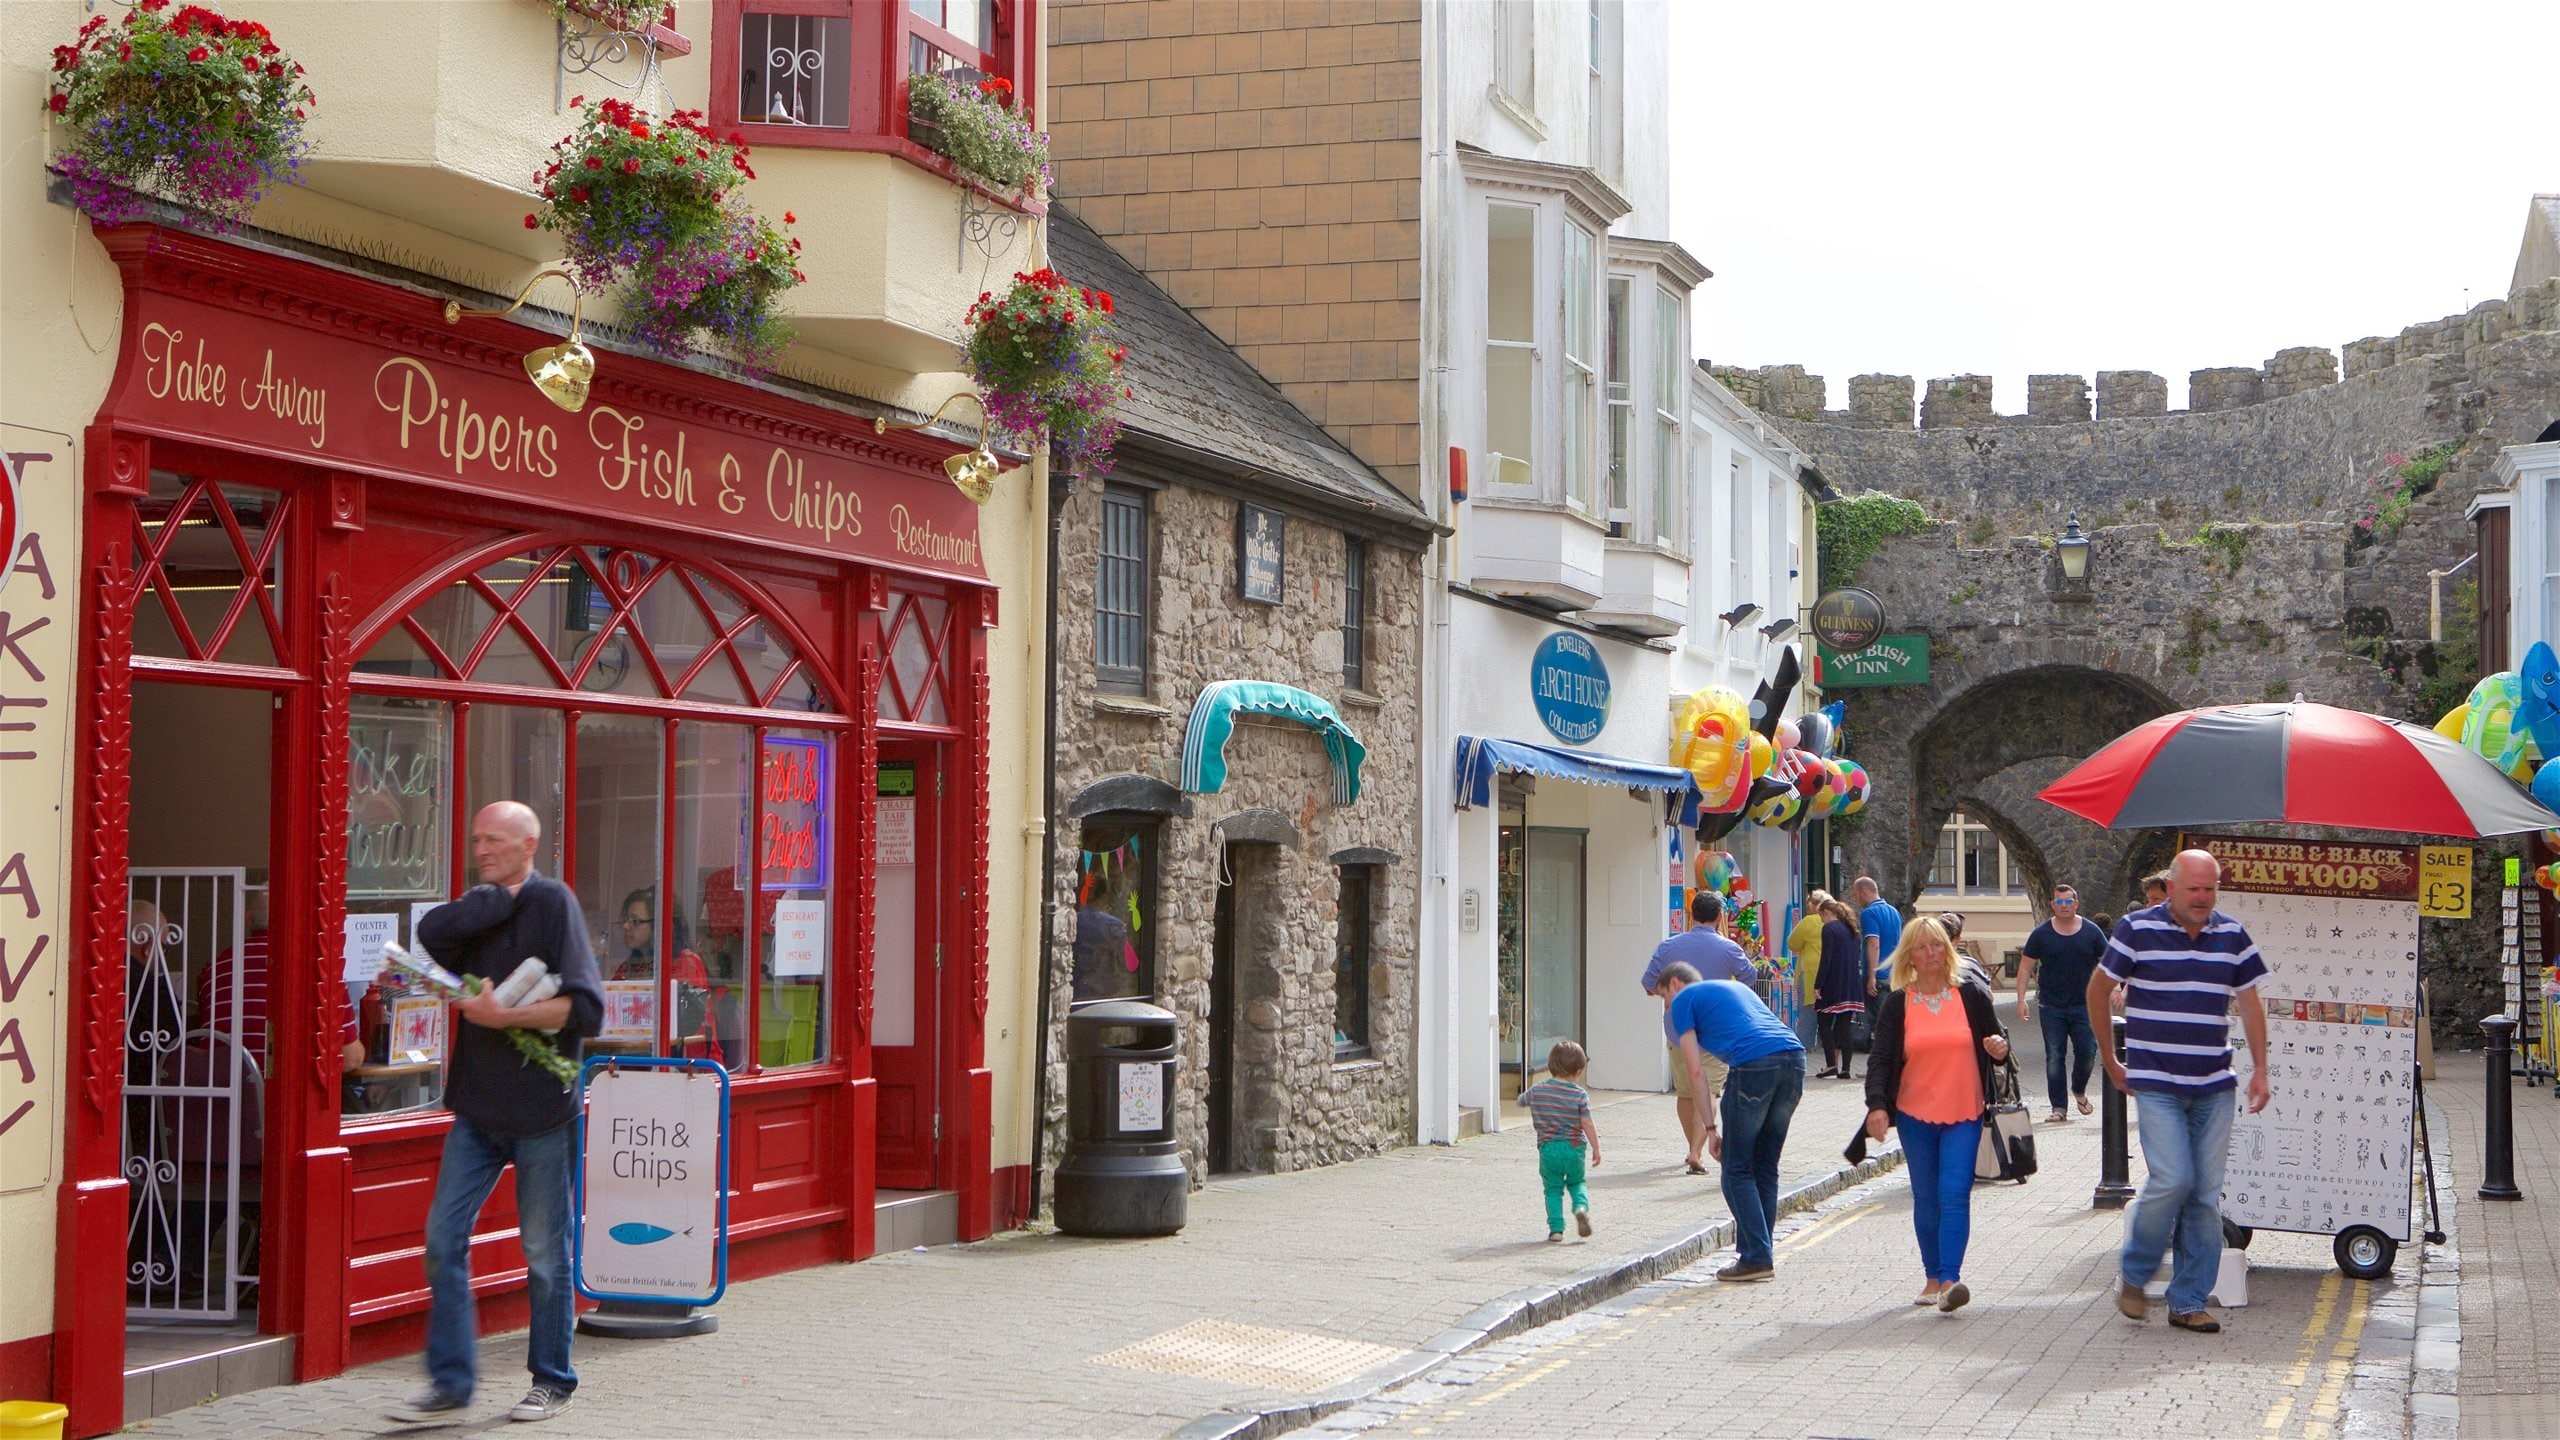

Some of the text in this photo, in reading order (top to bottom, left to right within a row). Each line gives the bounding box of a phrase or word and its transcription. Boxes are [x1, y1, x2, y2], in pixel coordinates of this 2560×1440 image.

[142, 322, 326, 448] Take Away
[374, 356, 862, 543] Pipers Fish & Chips
[889, 503, 979, 568] Restaurant
[1820, 615, 1874, 631] GUINNESS
[1556, 636, 1591, 661] JEWELLERS
[1867, 645, 1912, 667] BUSH
[1539, 665, 1606, 710] ARCH HOUSE
[1548, 709, 1597, 739] COLLECTABLES
[880, 801, 910, 809] CRAFT
[884, 811, 906, 820] FAIR
[762, 813, 814, 881] Chips
[879, 841, 911, 849] Imperial
[2206, 840, 2403, 866] GLITTER & BLACK
[2426, 853, 2467, 867] SALE
[2229, 859, 2379, 890] TATTOOS
[2244, 885, 2294, 893] WATERPROOF
[2304, 888, 2338, 896] ALLERGY
[2423, 882, 2466, 912] £3
[355, 921, 388, 931] COUNTER
[782, 911, 818, 921] RESTAURANT
[360, 934, 382, 943] STAFF
[613, 1150, 687, 1188] Chips
[595, 1275, 698, 1291] The Great British Take Away
